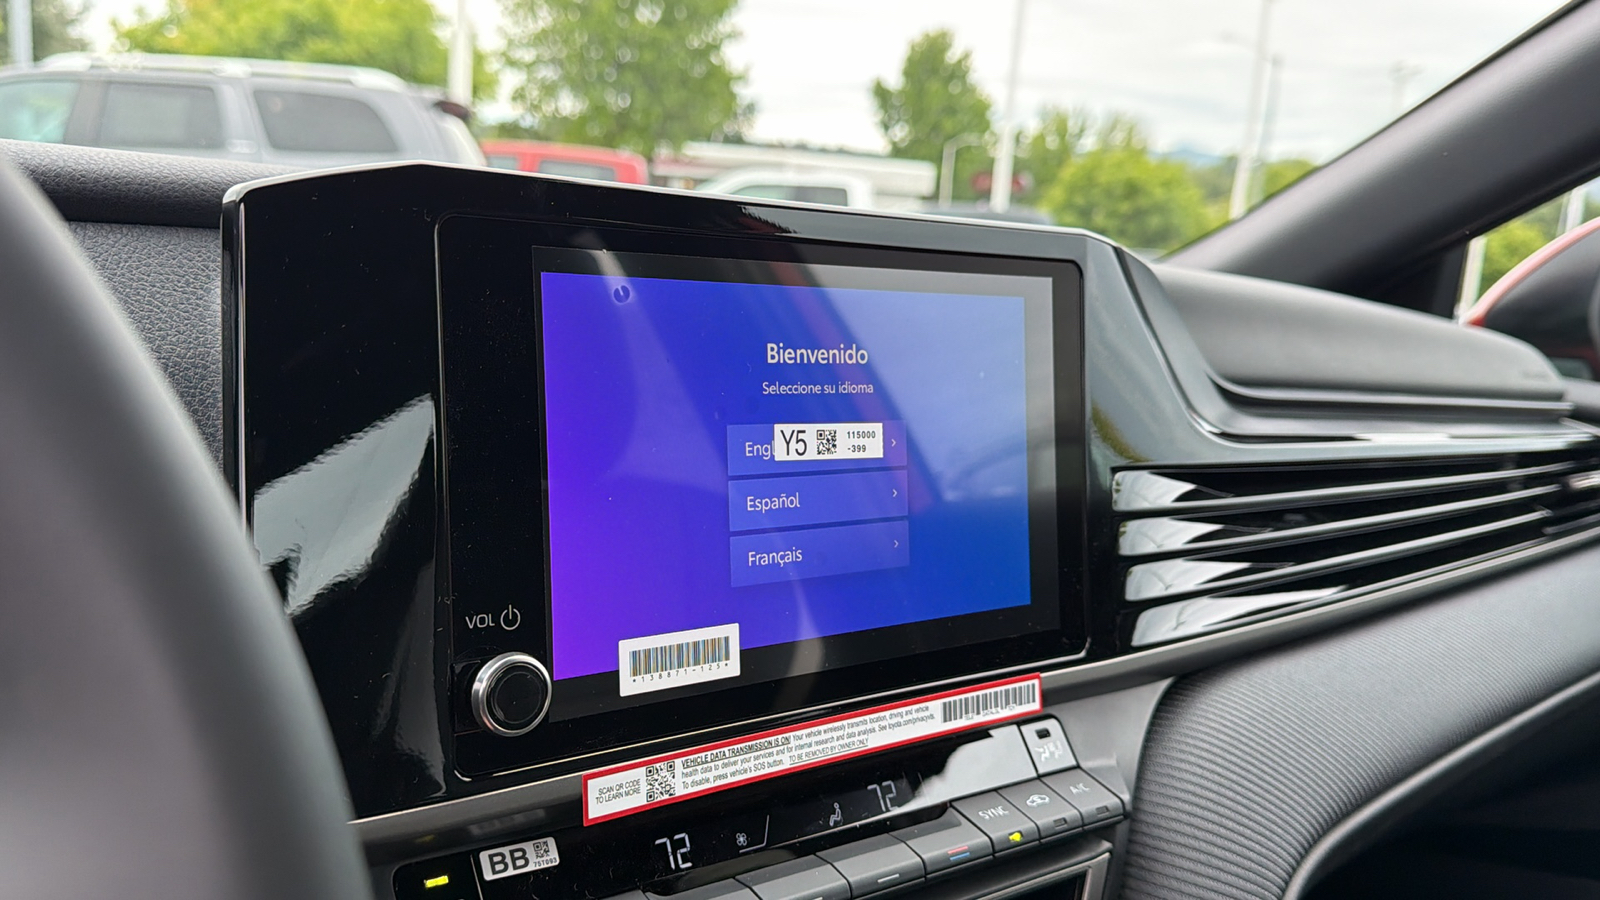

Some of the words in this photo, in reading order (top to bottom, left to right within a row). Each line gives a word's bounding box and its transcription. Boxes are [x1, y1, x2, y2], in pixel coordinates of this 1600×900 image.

[766, 342, 868, 364] Bienvenido
[762, 381, 821, 395] Seleccione
[823, 384, 835, 394] su
[838, 381, 874, 394] idioma
[780, 430, 807, 456] Y5
[847, 430, 876, 439] 115000
[745, 440, 775, 460] Engl
[847, 444, 866, 453] -399
[747, 492, 800, 513] Español
[748, 547, 802, 567] Français
[465, 613, 496, 629] VOL
[681, 753, 708, 768] VEHICLE
[710, 749, 726, 761] DATA
[727, 738, 772, 757] TRANSMISSION
[773, 737, 779, 746] IS
[780, 734, 791, 744] ON!
[792, 732, 803, 742] Your
[804, 727, 822, 739] vehicle
[823, 722, 846, 736] wirelessly
[846, 717, 867, 729] transmits
[888, 709, 903, 721] driving
[904, 707, 912, 716] and
[914, 703, 928, 714] vehicle
[681, 766, 698, 778] health
[699, 764, 712, 774] data
[713, 762, 719, 770] to
[720, 757, 739, 769] deliver
[740, 756, 752, 766] your
[753, 750, 774, 761] services
[775, 746, 785, 756] and
[794, 740, 812, 751] internal
[813, 734, 834, 746] research
[835, 732, 844, 741] and
[846, 729, 856, 739] data
[877, 722, 886, 731] See
[682, 780, 689, 790] To
[712, 771, 728, 784] press
[753, 761, 765, 772] SOS
[788, 754, 796, 763] TO
[797, 752, 803, 760] BE
[804, 746, 829, 759] REMOVED
[830, 744, 836, 752] BY
[837, 739, 855, 751] OWNER
[855, 736, 868, 746] ONLY
[595, 795, 604, 804] TO
[605, 790, 623, 802] LEARN
[624, 786, 640, 797] MORE
[598, 784, 614, 796] SCAN
[624, 778, 640, 789] CODE
[867, 780, 899, 812] 72
[1069, 782, 1091, 794] A/C
[978, 805, 1010, 820] SYNC
[655, 832, 693, 870] 72
[488, 847, 530, 876] BB
